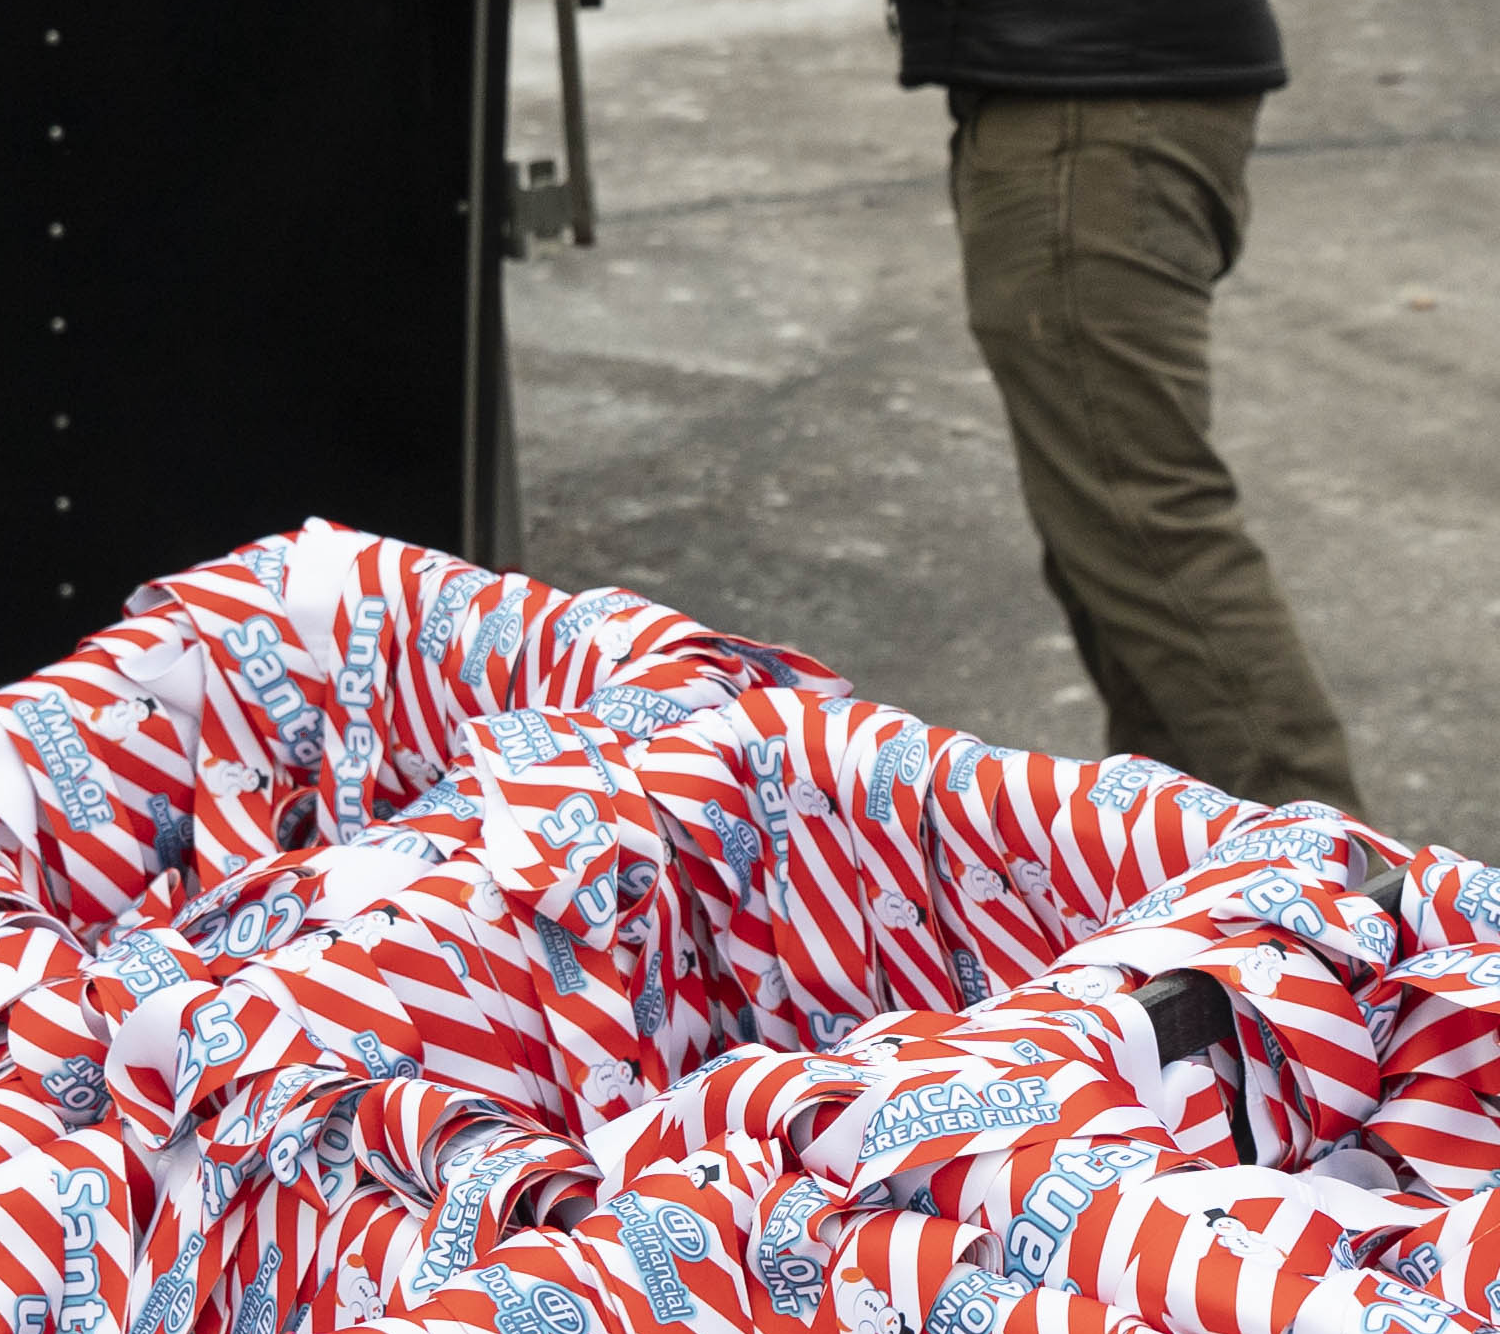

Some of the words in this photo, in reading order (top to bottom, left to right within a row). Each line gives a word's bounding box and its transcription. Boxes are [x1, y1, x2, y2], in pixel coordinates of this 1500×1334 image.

[338, 598, 387, 707] Run
[18, 701, 70, 790] GREATER
[55, 781, 89, 831] FLINT
[35, 694, 92, 779] YMCA
[76, 781, 113, 824] OF
[900, 740, 927, 784] df
[706, 803, 733, 839] Dort
[1223, 838, 1323, 871] YMCA
[357, 1034, 387, 1078] Dort
[48, 1076, 95, 1109] OF
[862, 1085, 981, 1140] YMCA
[986, 1080, 1045, 1108] OF
[861, 1113, 978, 1160] GREATER
[981, 1103, 1057, 1127] FLINT
[416, 1177, 474, 1288] YMCA
[658, 1206, 705, 1259] df
[1012, 1144, 1152, 1279] anta
[175, 1235, 202, 1280] Dort
[614, 1195, 648, 1231] Dort
[640, 1224, 691, 1316] Financial
[623, 1228, 646, 1277] CREDIT
[644, 1277, 669, 1320] UNION
[761, 1243, 799, 1313] FLINT
[783, 1257, 823, 1309] OF
[168, 1285, 195, 1331] df
[480, 1268, 520, 1307] Dort
